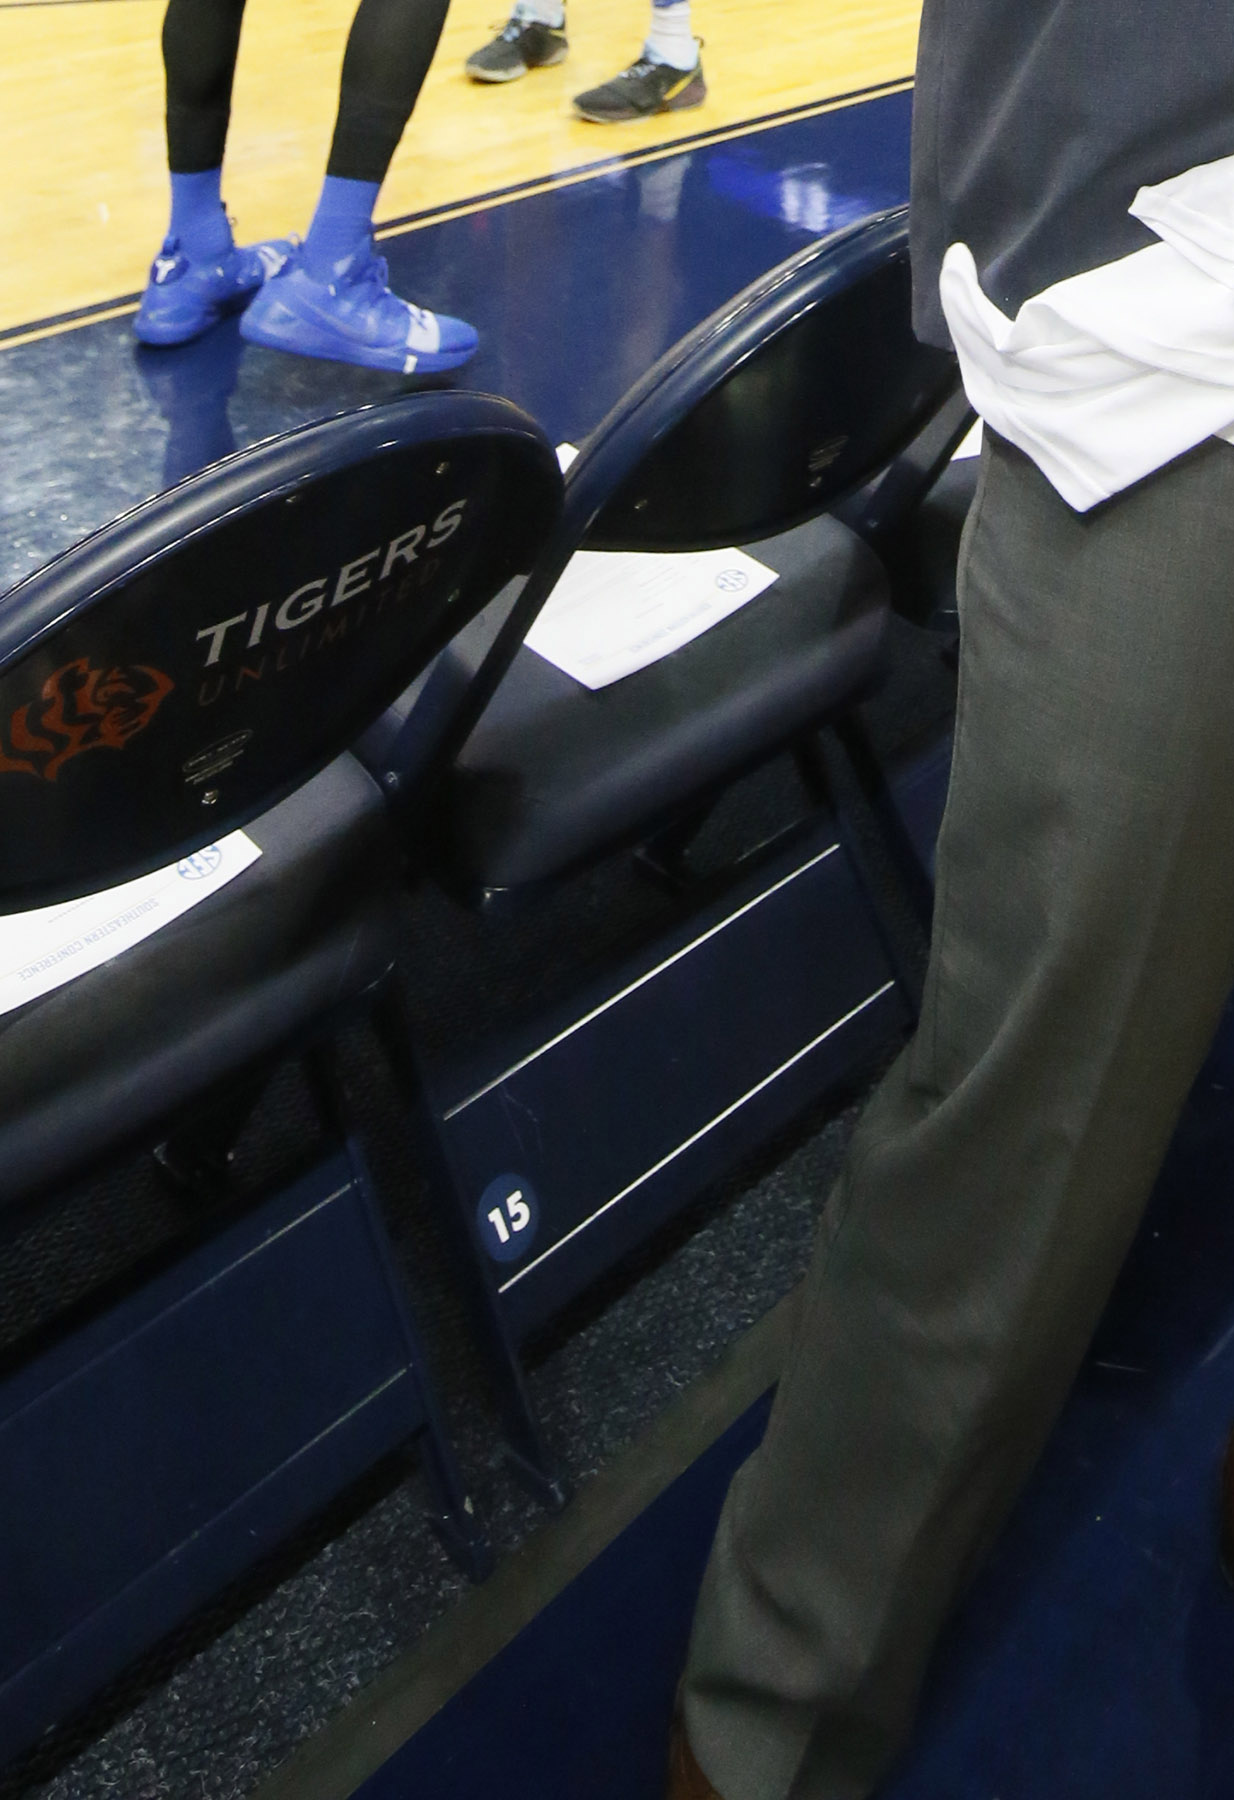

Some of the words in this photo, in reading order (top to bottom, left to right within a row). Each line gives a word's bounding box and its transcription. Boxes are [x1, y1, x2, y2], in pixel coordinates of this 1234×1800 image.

[196, 499, 468, 668] TIGERS
[83, 897, 160, 947] SOUTHEASTERN
[16, 938, 84, 982] CONFERENCE
[487, 1189, 531, 1244] 15
